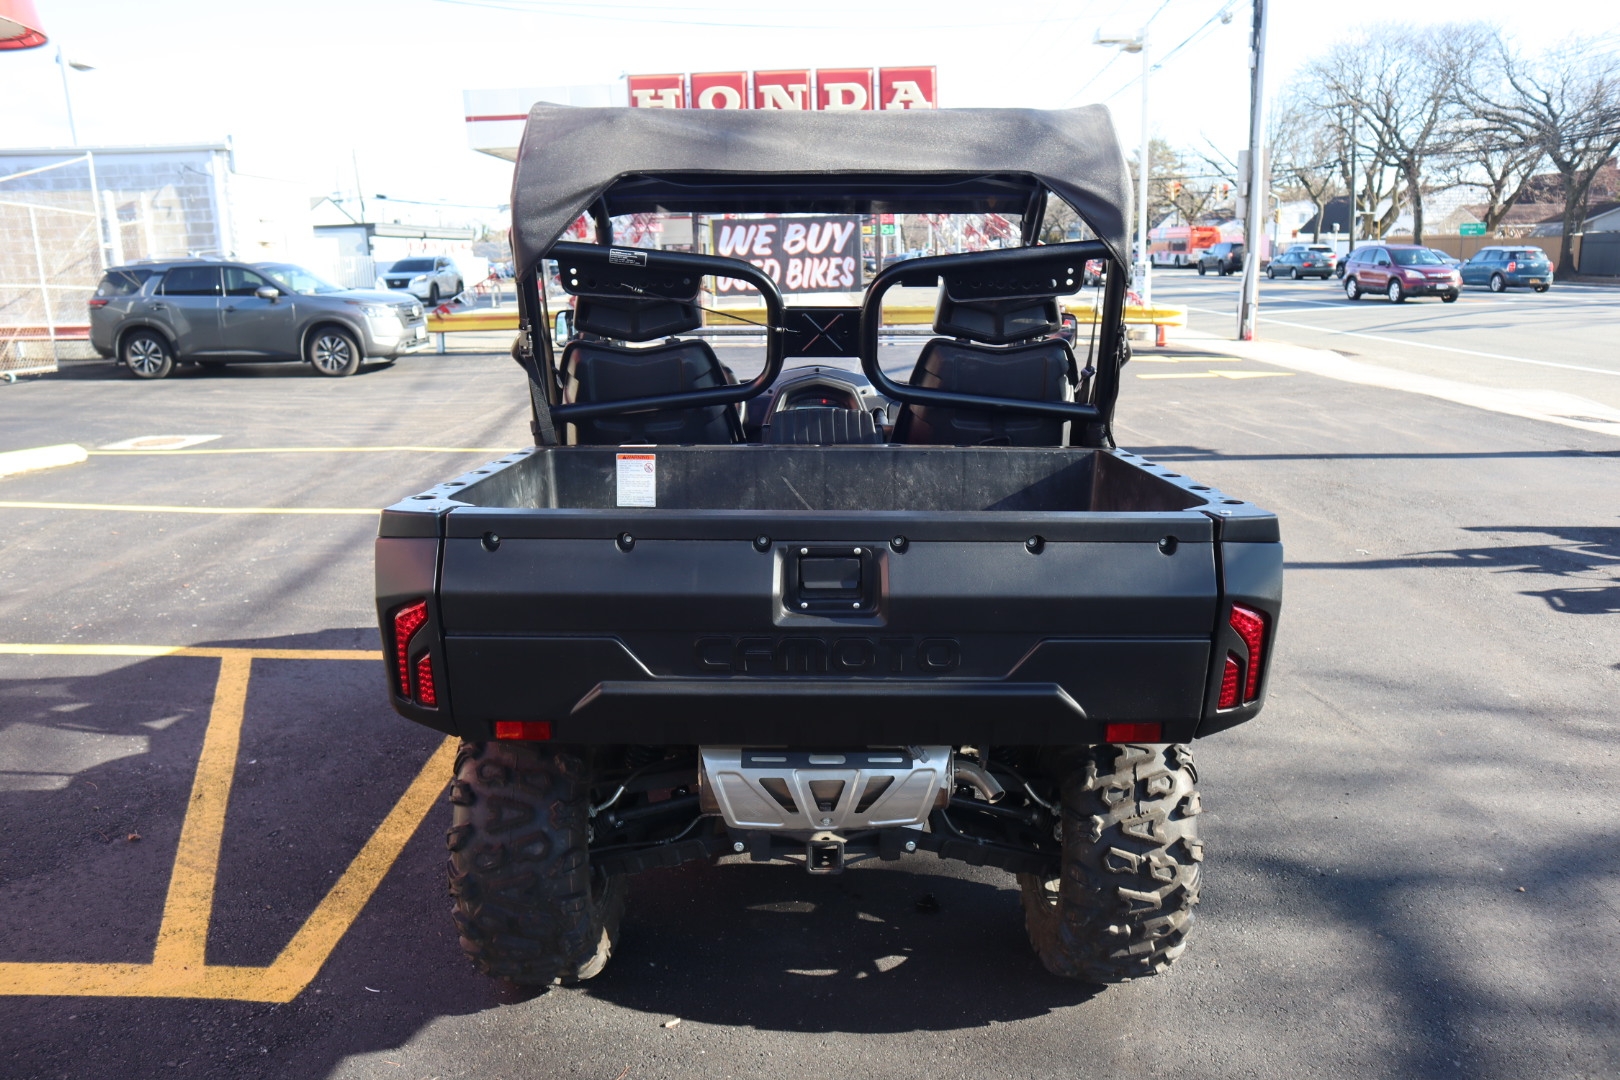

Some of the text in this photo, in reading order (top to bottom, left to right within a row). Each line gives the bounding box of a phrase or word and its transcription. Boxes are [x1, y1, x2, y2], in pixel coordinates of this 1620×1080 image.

[632, 81, 932, 110] HONDA
[718, 221, 856, 256] WE BUY
[785, 256, 856, 290] BIKES
[694, 637, 961, 672] CFMOTO
